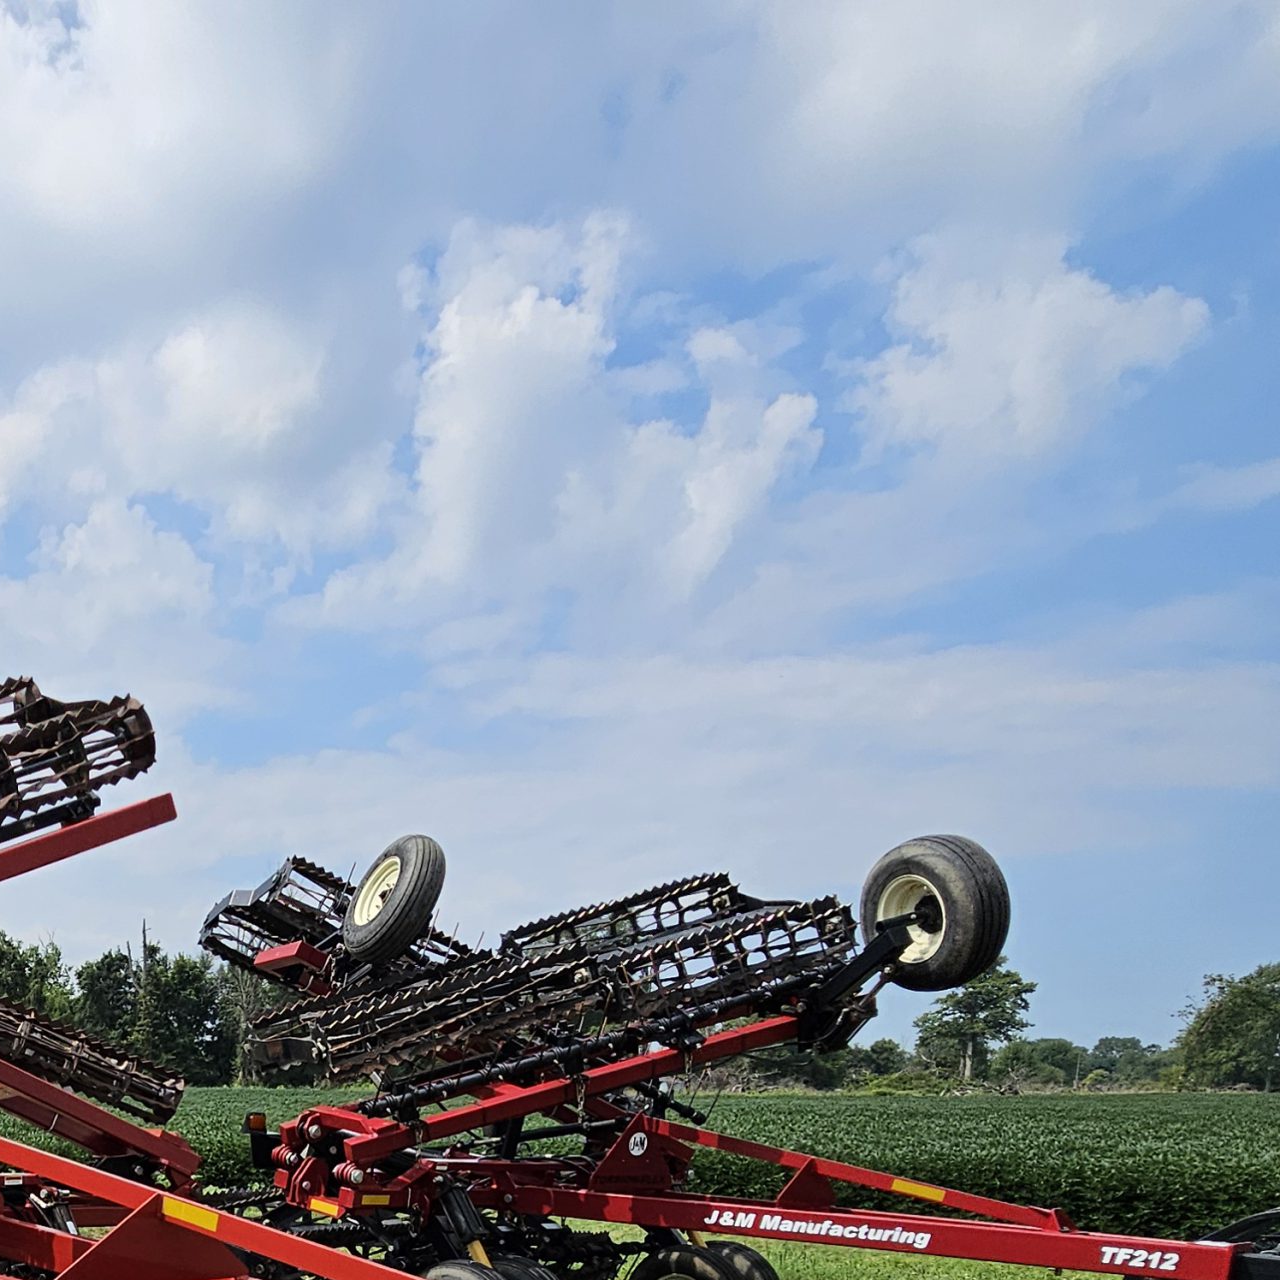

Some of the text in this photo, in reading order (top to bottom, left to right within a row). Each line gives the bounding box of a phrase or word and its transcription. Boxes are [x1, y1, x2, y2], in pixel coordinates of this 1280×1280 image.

[704, 1210, 932, 1249] J&M Manufacturing
[1101, 1246, 1180, 1271] TF212
